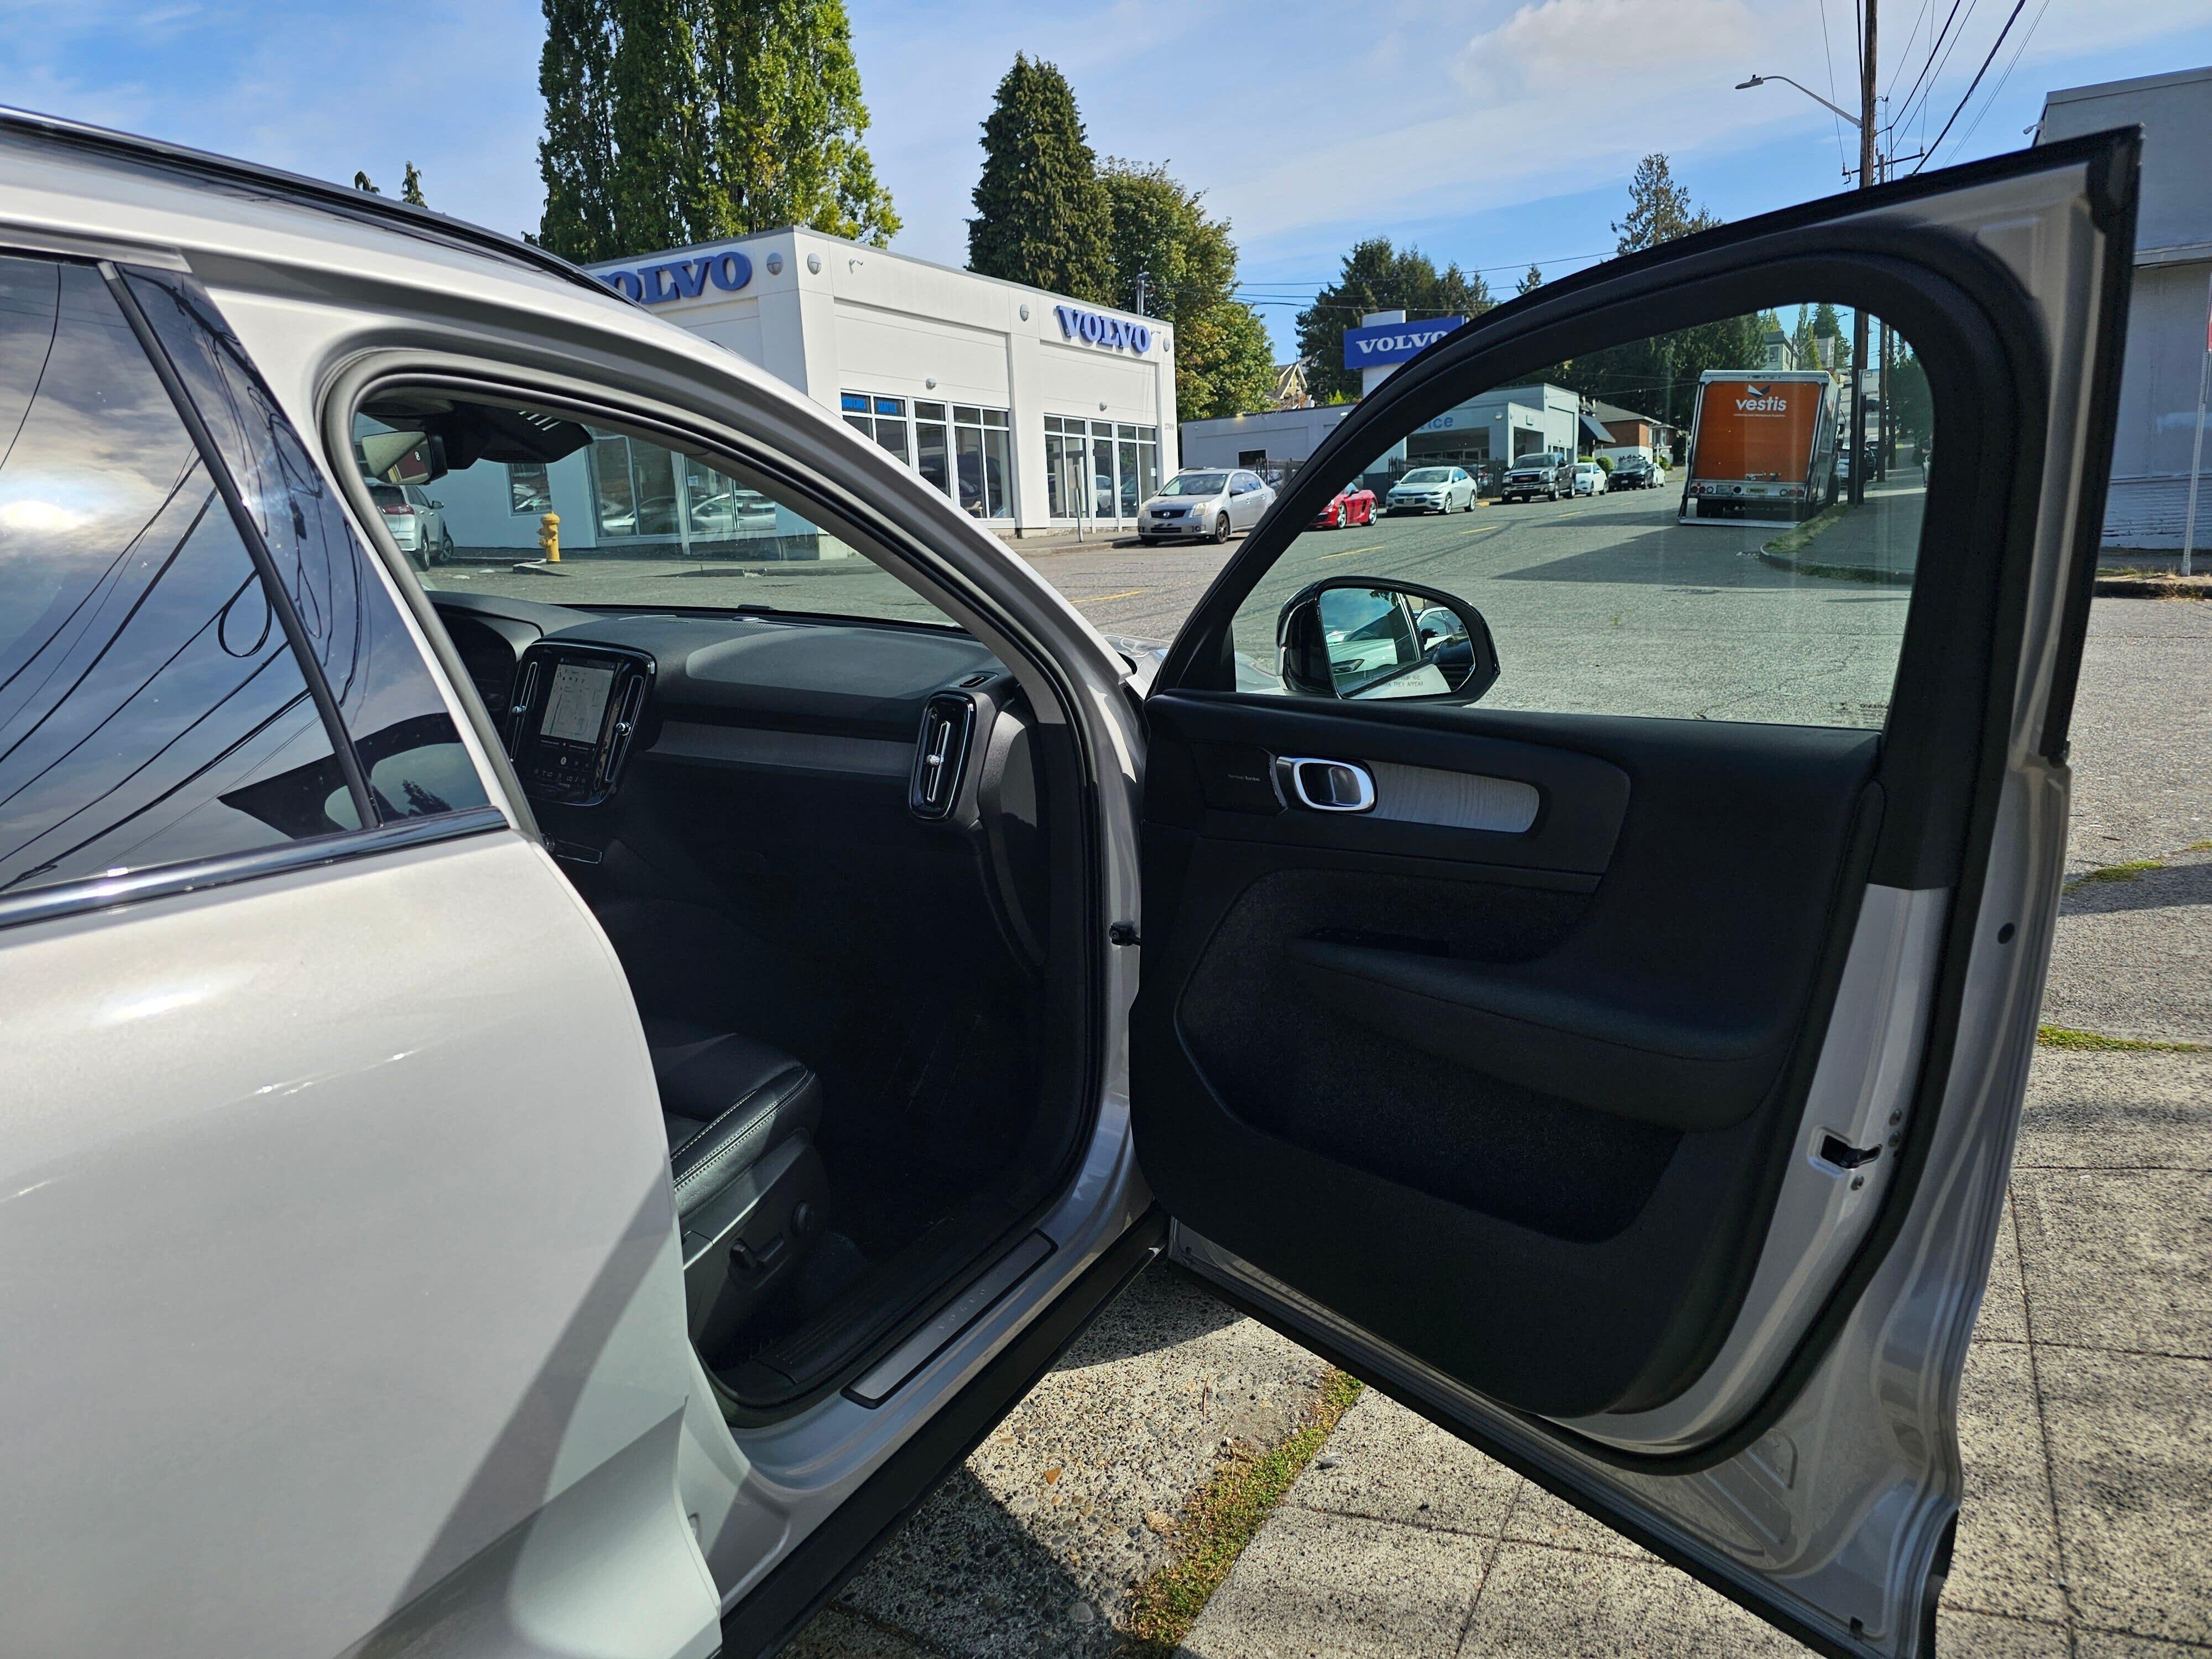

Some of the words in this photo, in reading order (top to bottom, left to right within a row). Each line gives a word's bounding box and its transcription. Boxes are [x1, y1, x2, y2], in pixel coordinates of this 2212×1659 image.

[597, 252, 753, 304] OLVO
[1056, 305, 1151, 353] VOLVO
[1735, 396, 1787, 411] vestis
